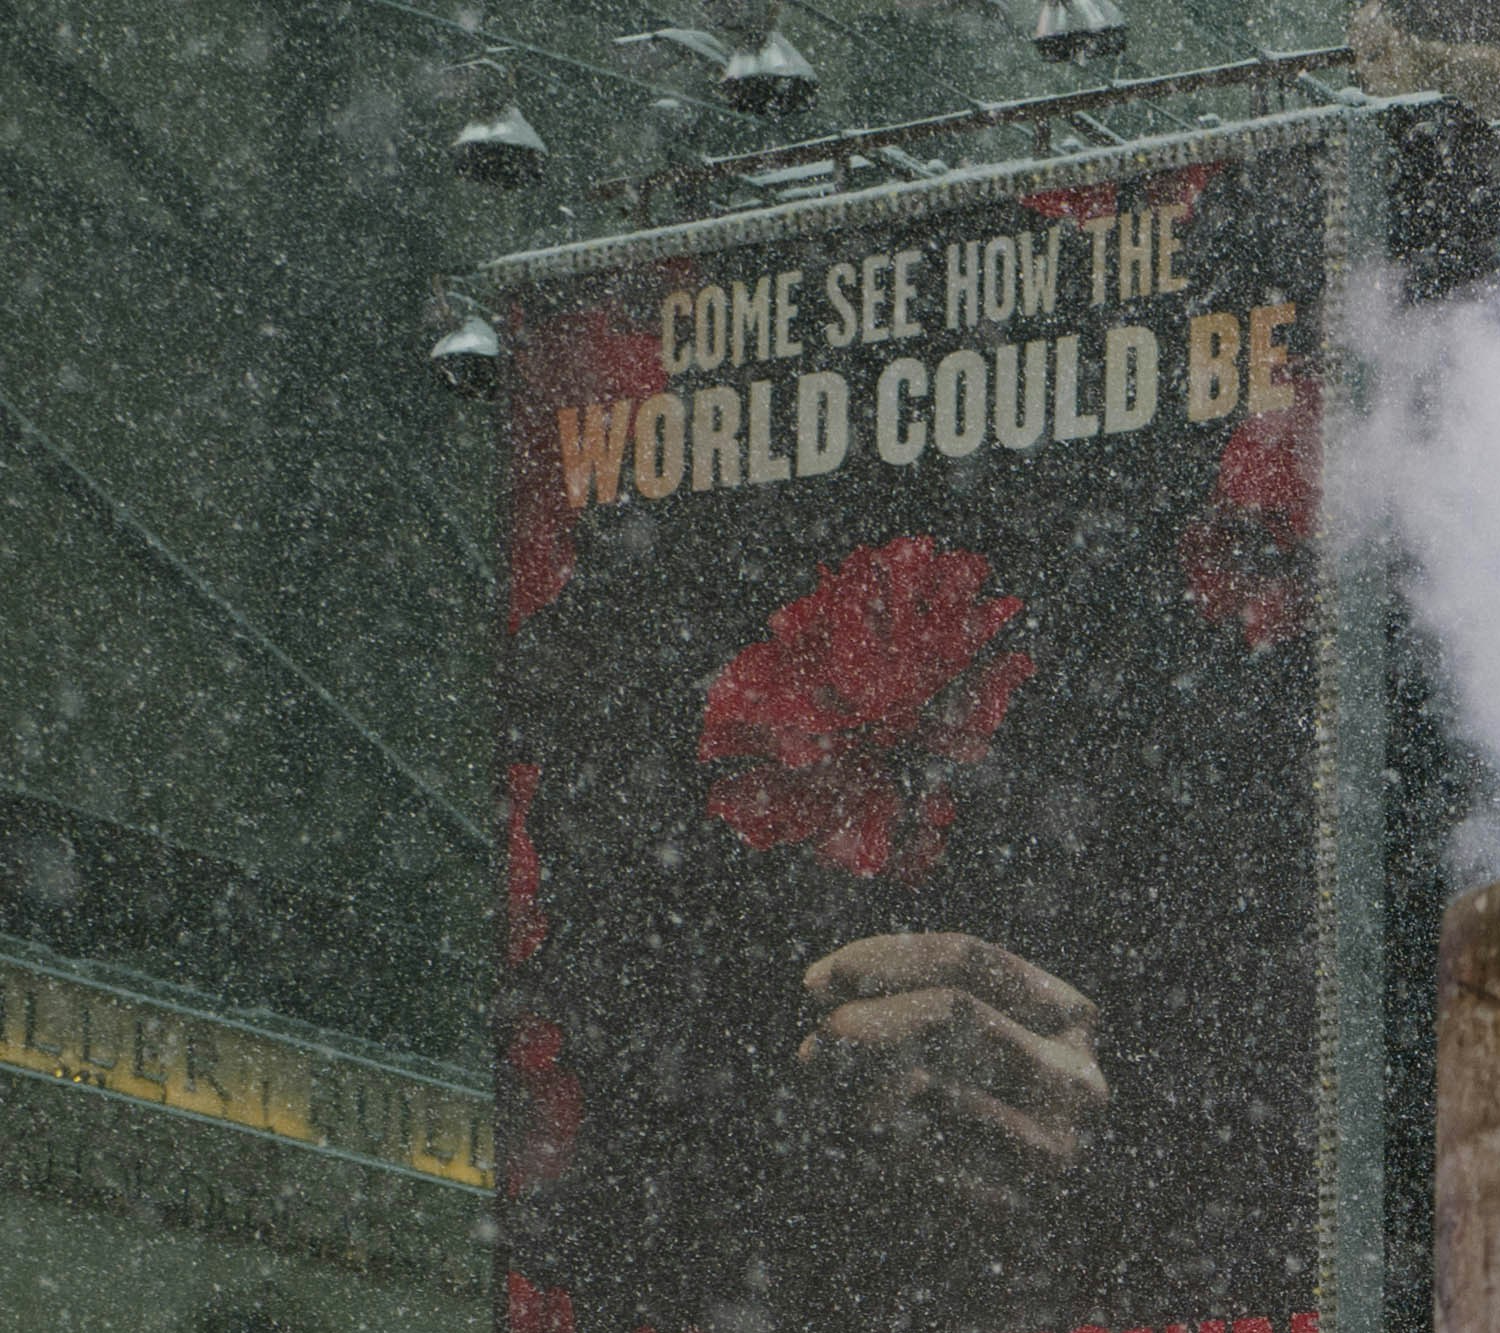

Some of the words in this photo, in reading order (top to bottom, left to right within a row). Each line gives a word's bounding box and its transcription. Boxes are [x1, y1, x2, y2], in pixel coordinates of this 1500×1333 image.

[662, 270, 802, 376] COME
[825, 249, 922, 350] SEE
[947, 224, 1061, 323] HOW
[1092, 203, 1190, 306] THE
[557, 371, 850, 510] WORLD
[876, 324, 1162, 468] COULD
[1187, 302, 1297, 424] BE
